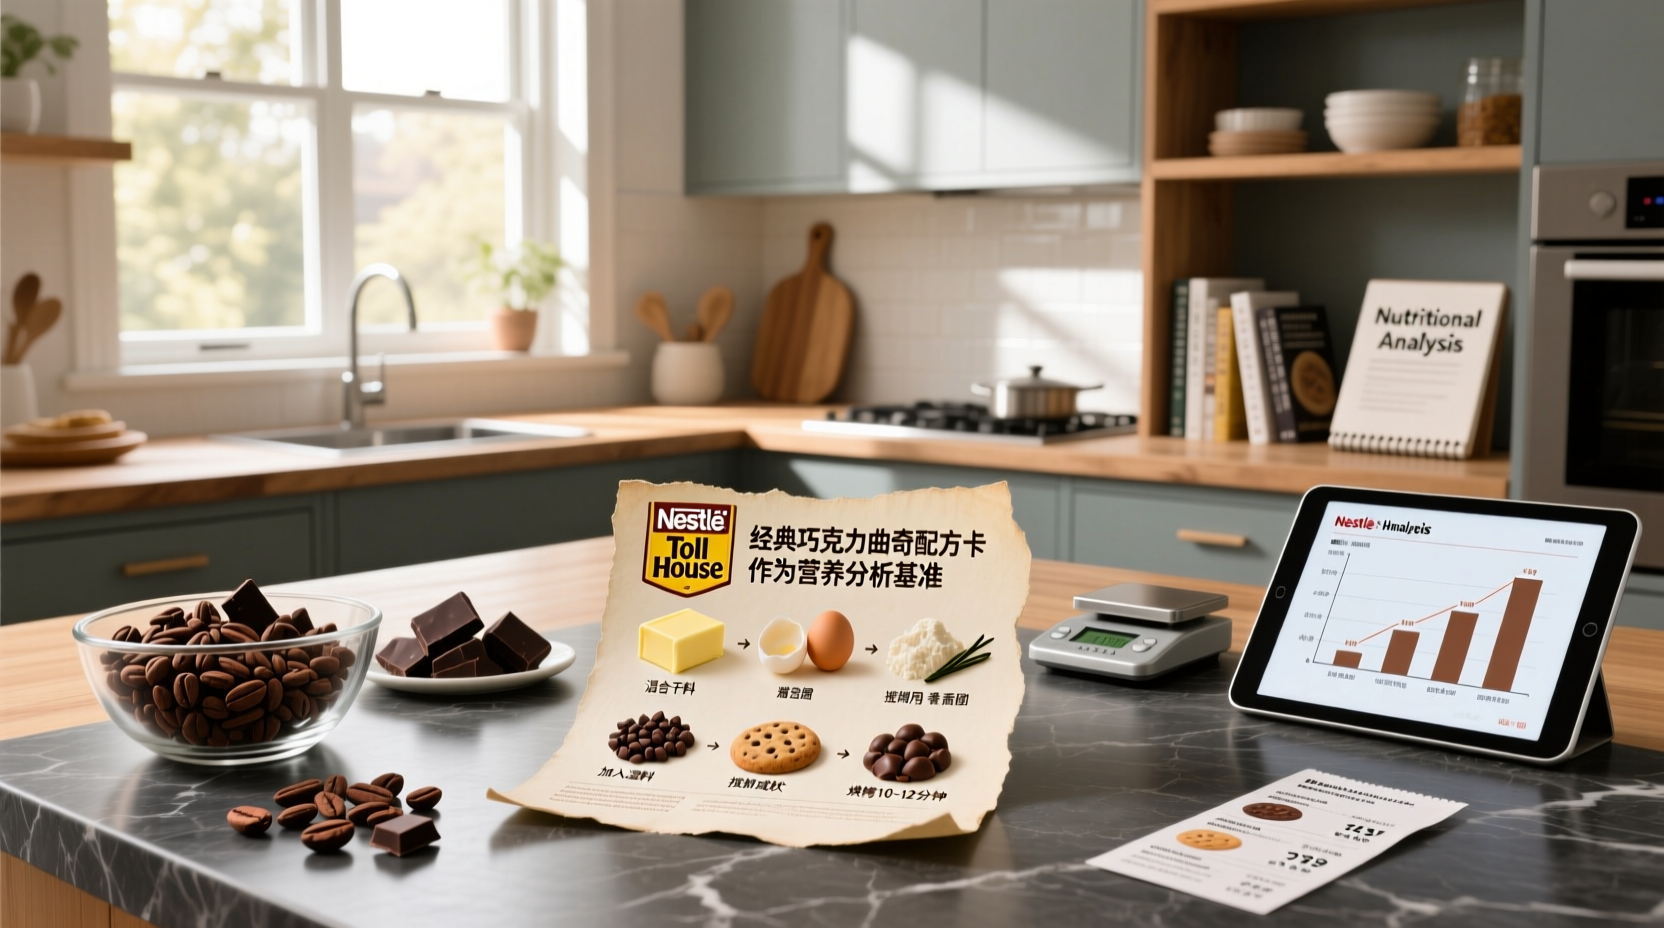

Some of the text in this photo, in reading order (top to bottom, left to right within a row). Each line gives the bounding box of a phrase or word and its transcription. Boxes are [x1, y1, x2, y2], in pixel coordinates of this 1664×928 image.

[1375, 307, 1482, 328] Nutritional
[1377, 332, 1463, 357] Analysis
[666, 536, 709, 560] Toll
[749, 524, 987, 558] 经典巧克力曲奇配方卡
[653, 556, 724, 579] House
[748, 557, 943, 589] 作为营养分析基准
